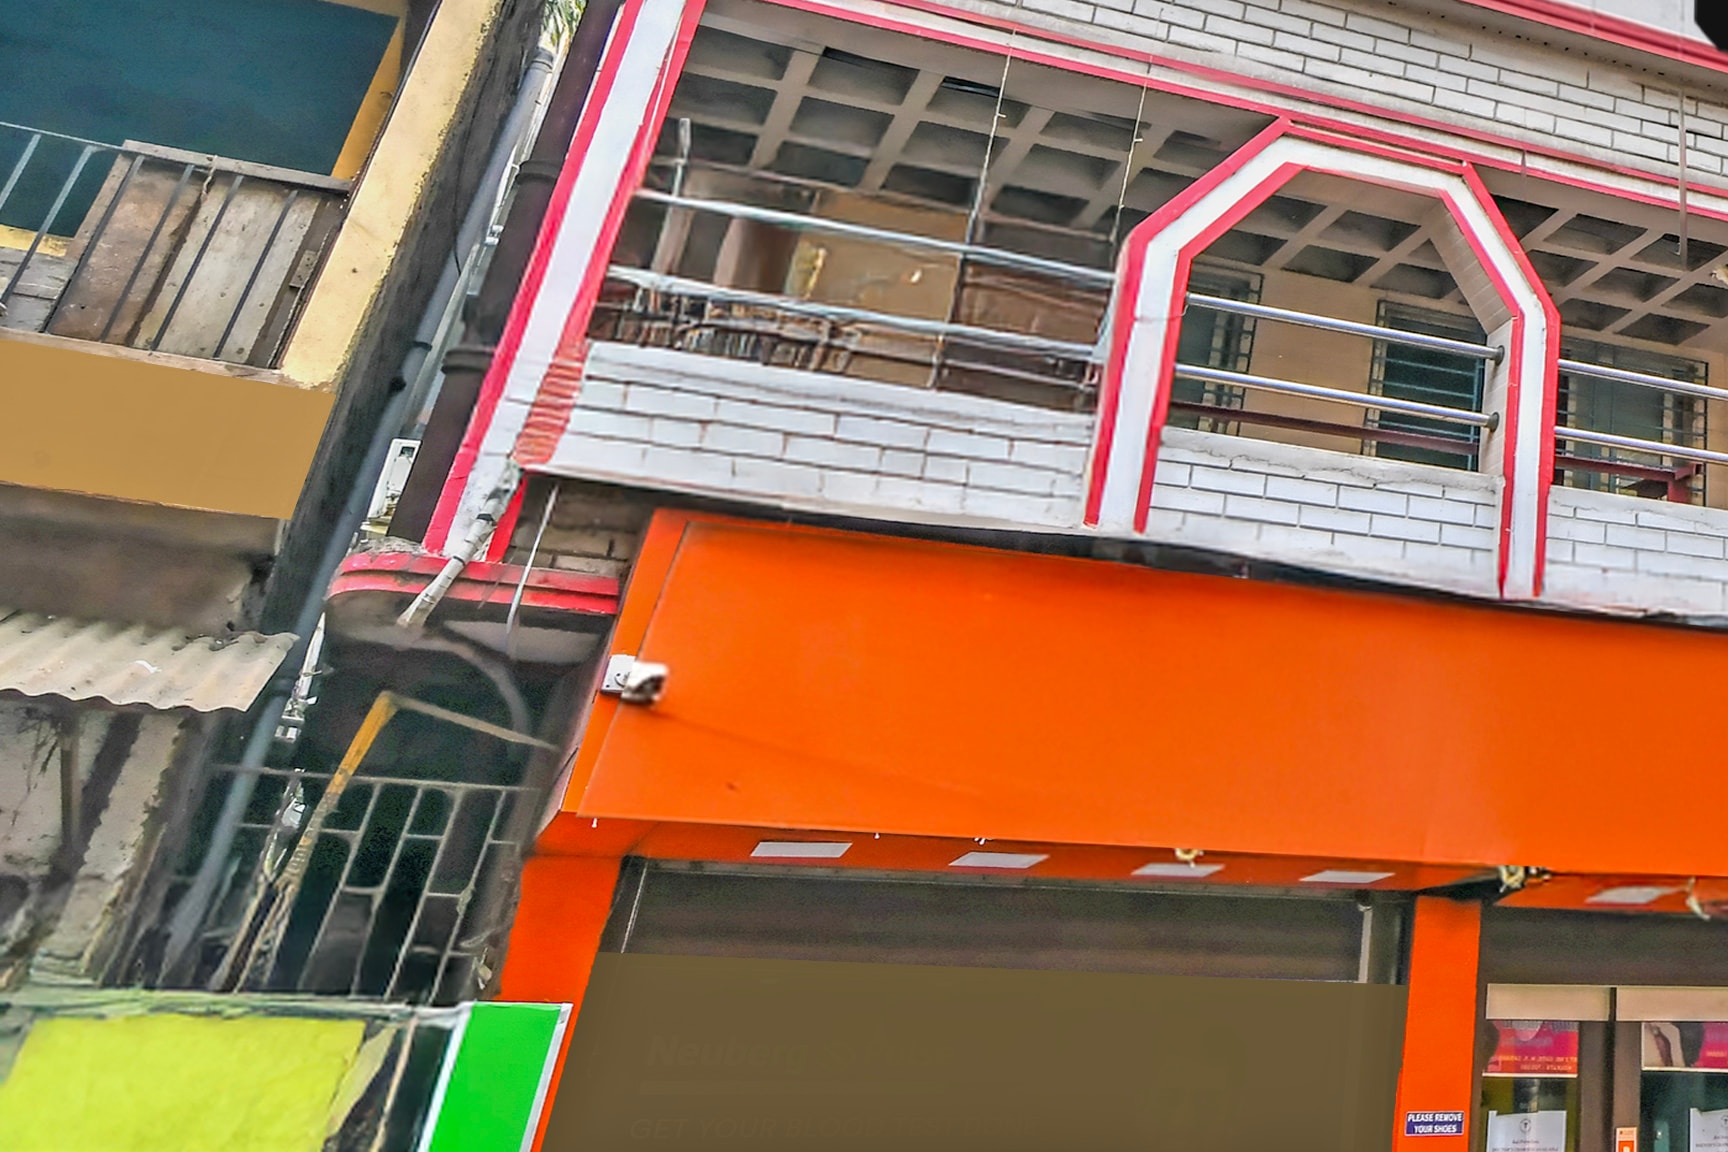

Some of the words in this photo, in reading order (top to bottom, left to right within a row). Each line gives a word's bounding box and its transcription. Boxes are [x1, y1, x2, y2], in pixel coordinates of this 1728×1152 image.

[1407, 1113, 1434, 1122] PLEASE
[1413, 1125, 1434, 1133] YOUR
[1434, 1124, 1457, 1133] SHOES
